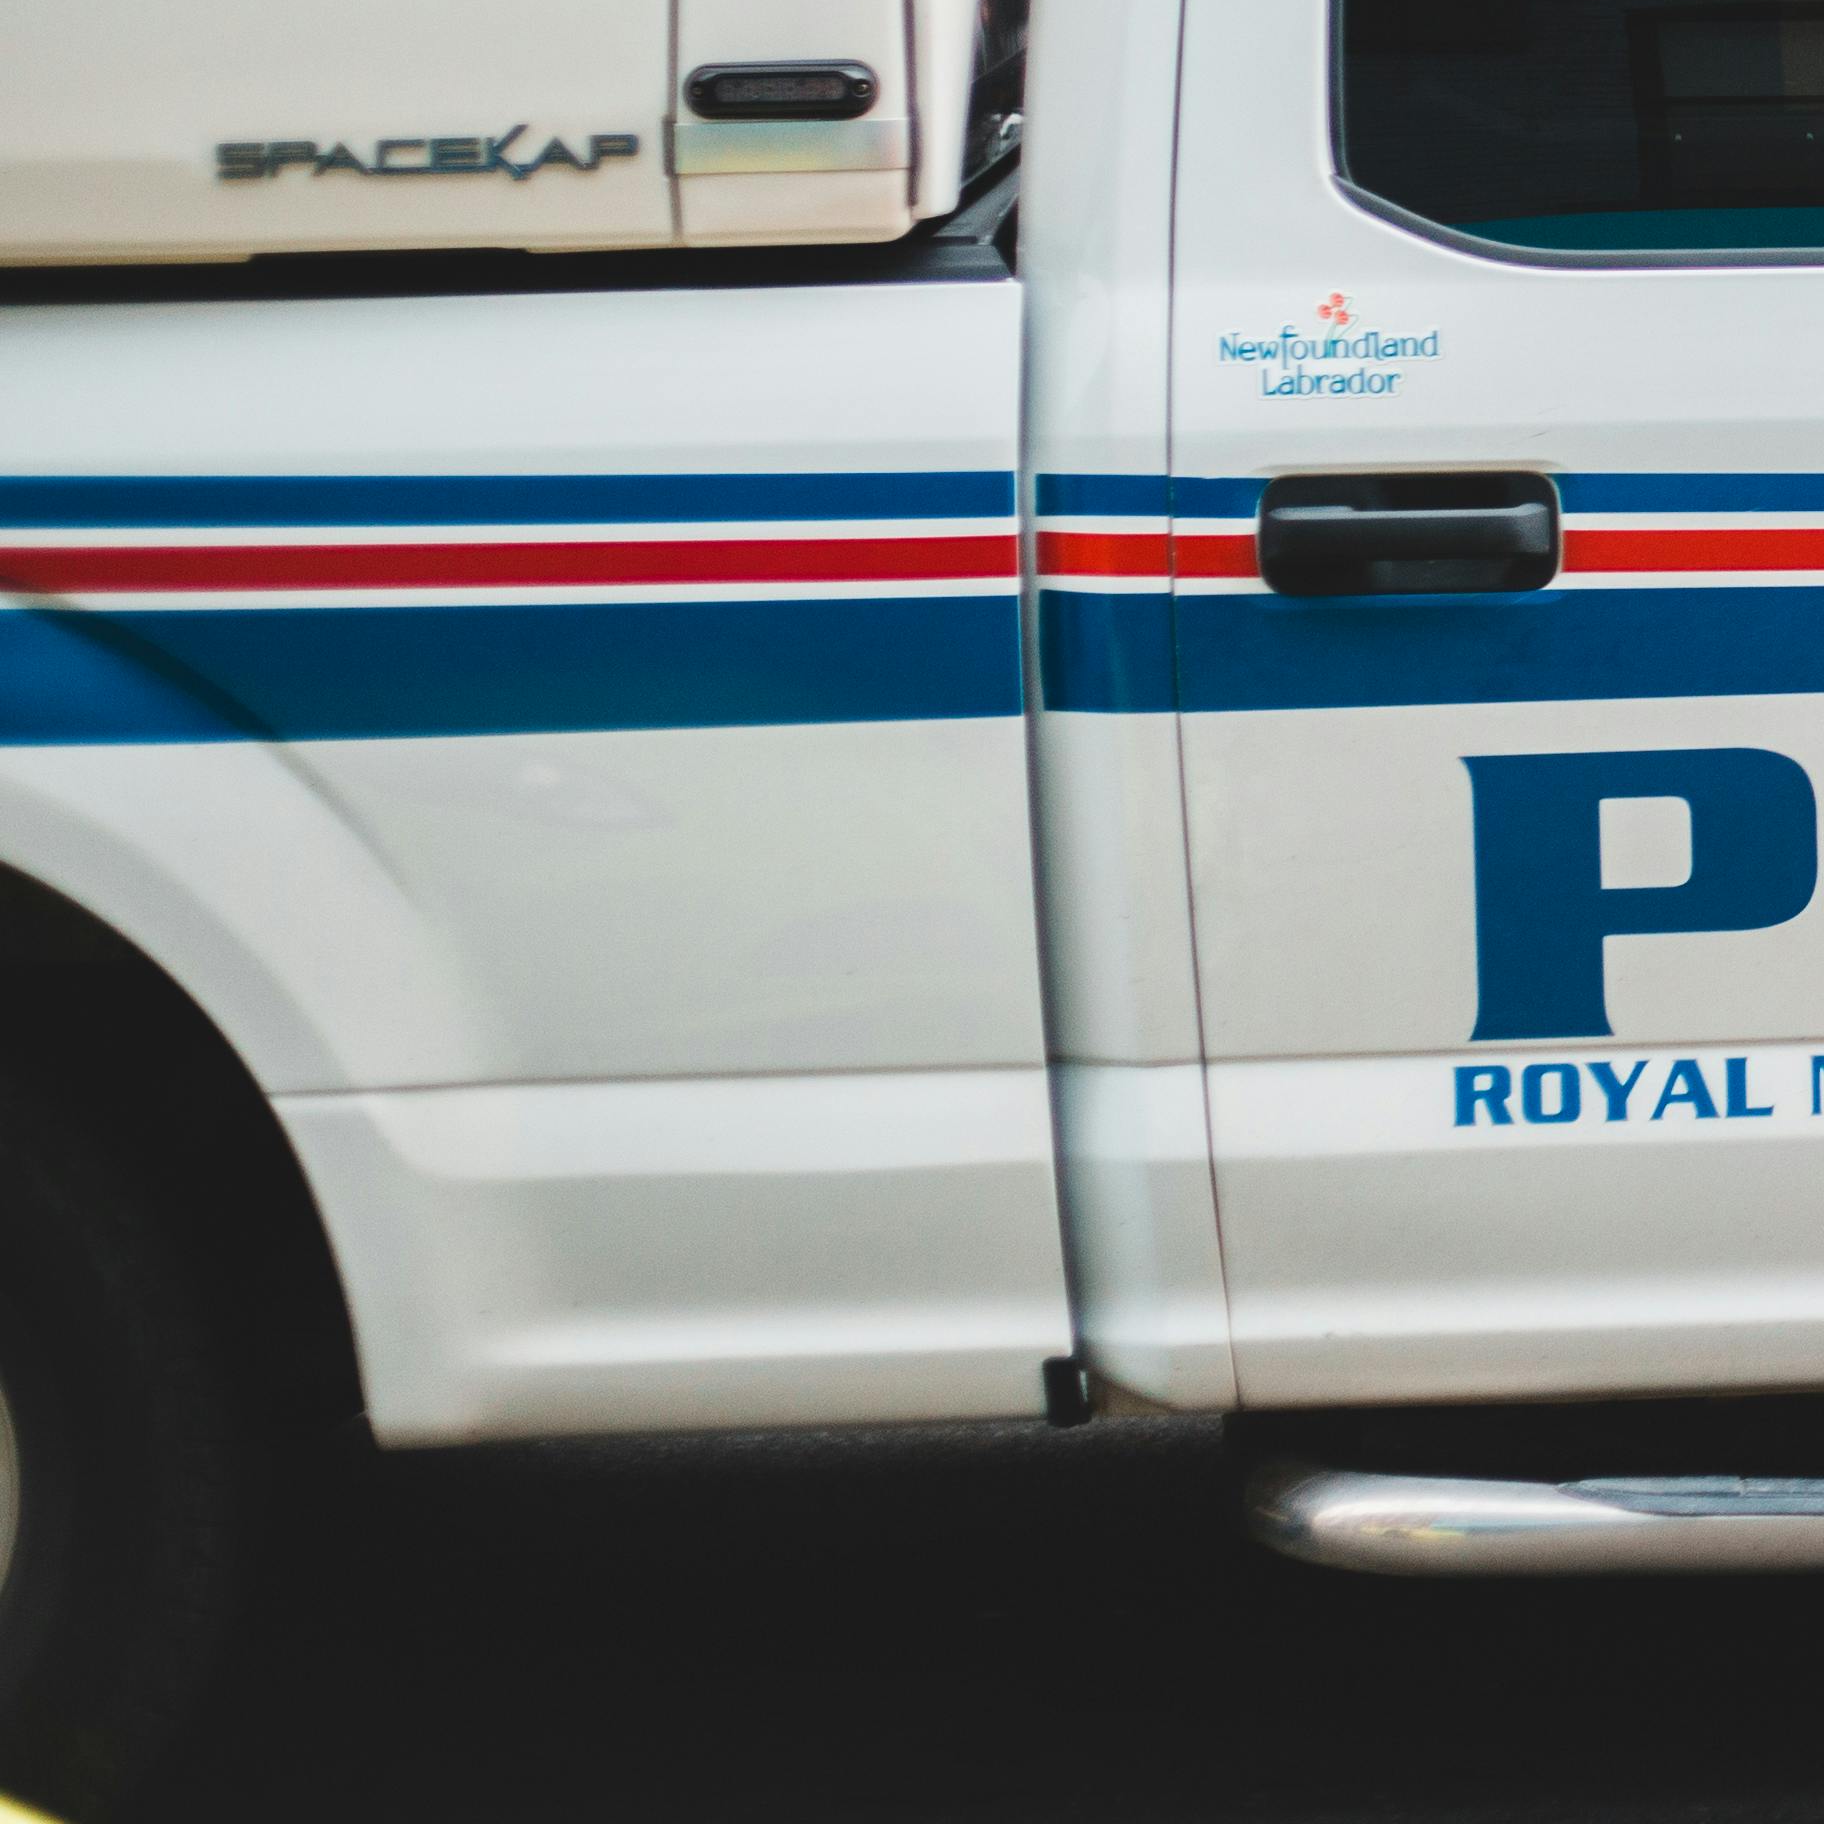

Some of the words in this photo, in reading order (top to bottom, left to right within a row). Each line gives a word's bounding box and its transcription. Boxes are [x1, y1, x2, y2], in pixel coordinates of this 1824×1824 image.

[216, 124, 640, 181] SPACEKAP
[1219, 325, 1440, 370] Newfoundland
[1262, 364, 1401, 396] Labrador
[1453, 1057, 1775, 1128] ROYAL
